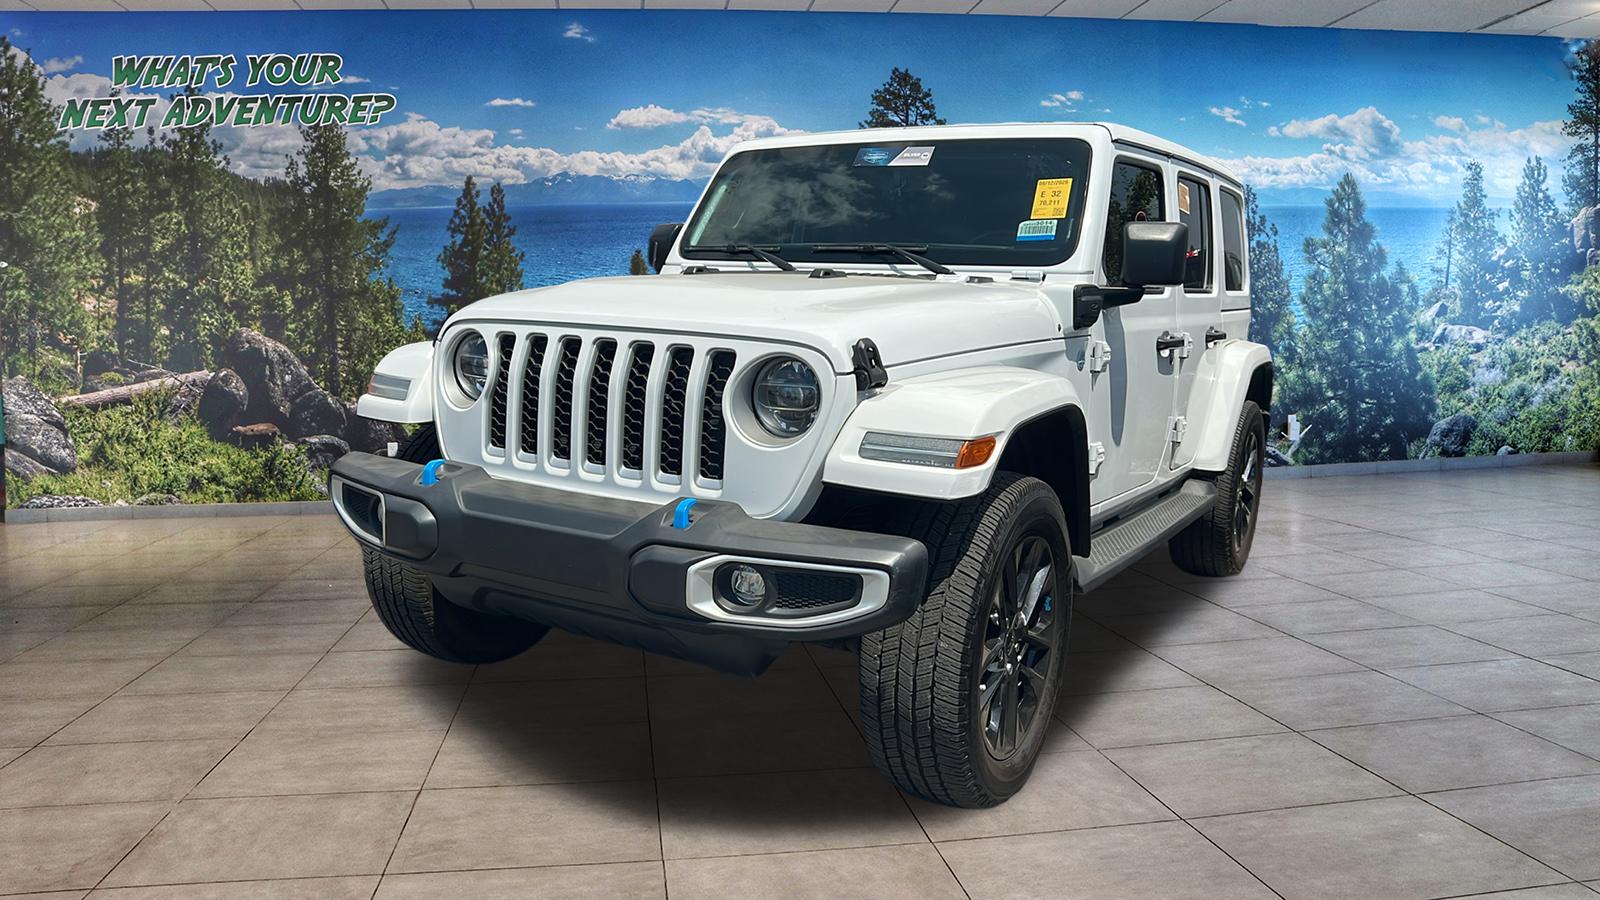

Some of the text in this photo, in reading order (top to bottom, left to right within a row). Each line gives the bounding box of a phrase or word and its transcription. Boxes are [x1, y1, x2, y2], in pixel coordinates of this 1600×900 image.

[111, 53, 343, 89] WHAT'S YOUR
[58, 93, 397, 131] NEXT ADVENTURE?
